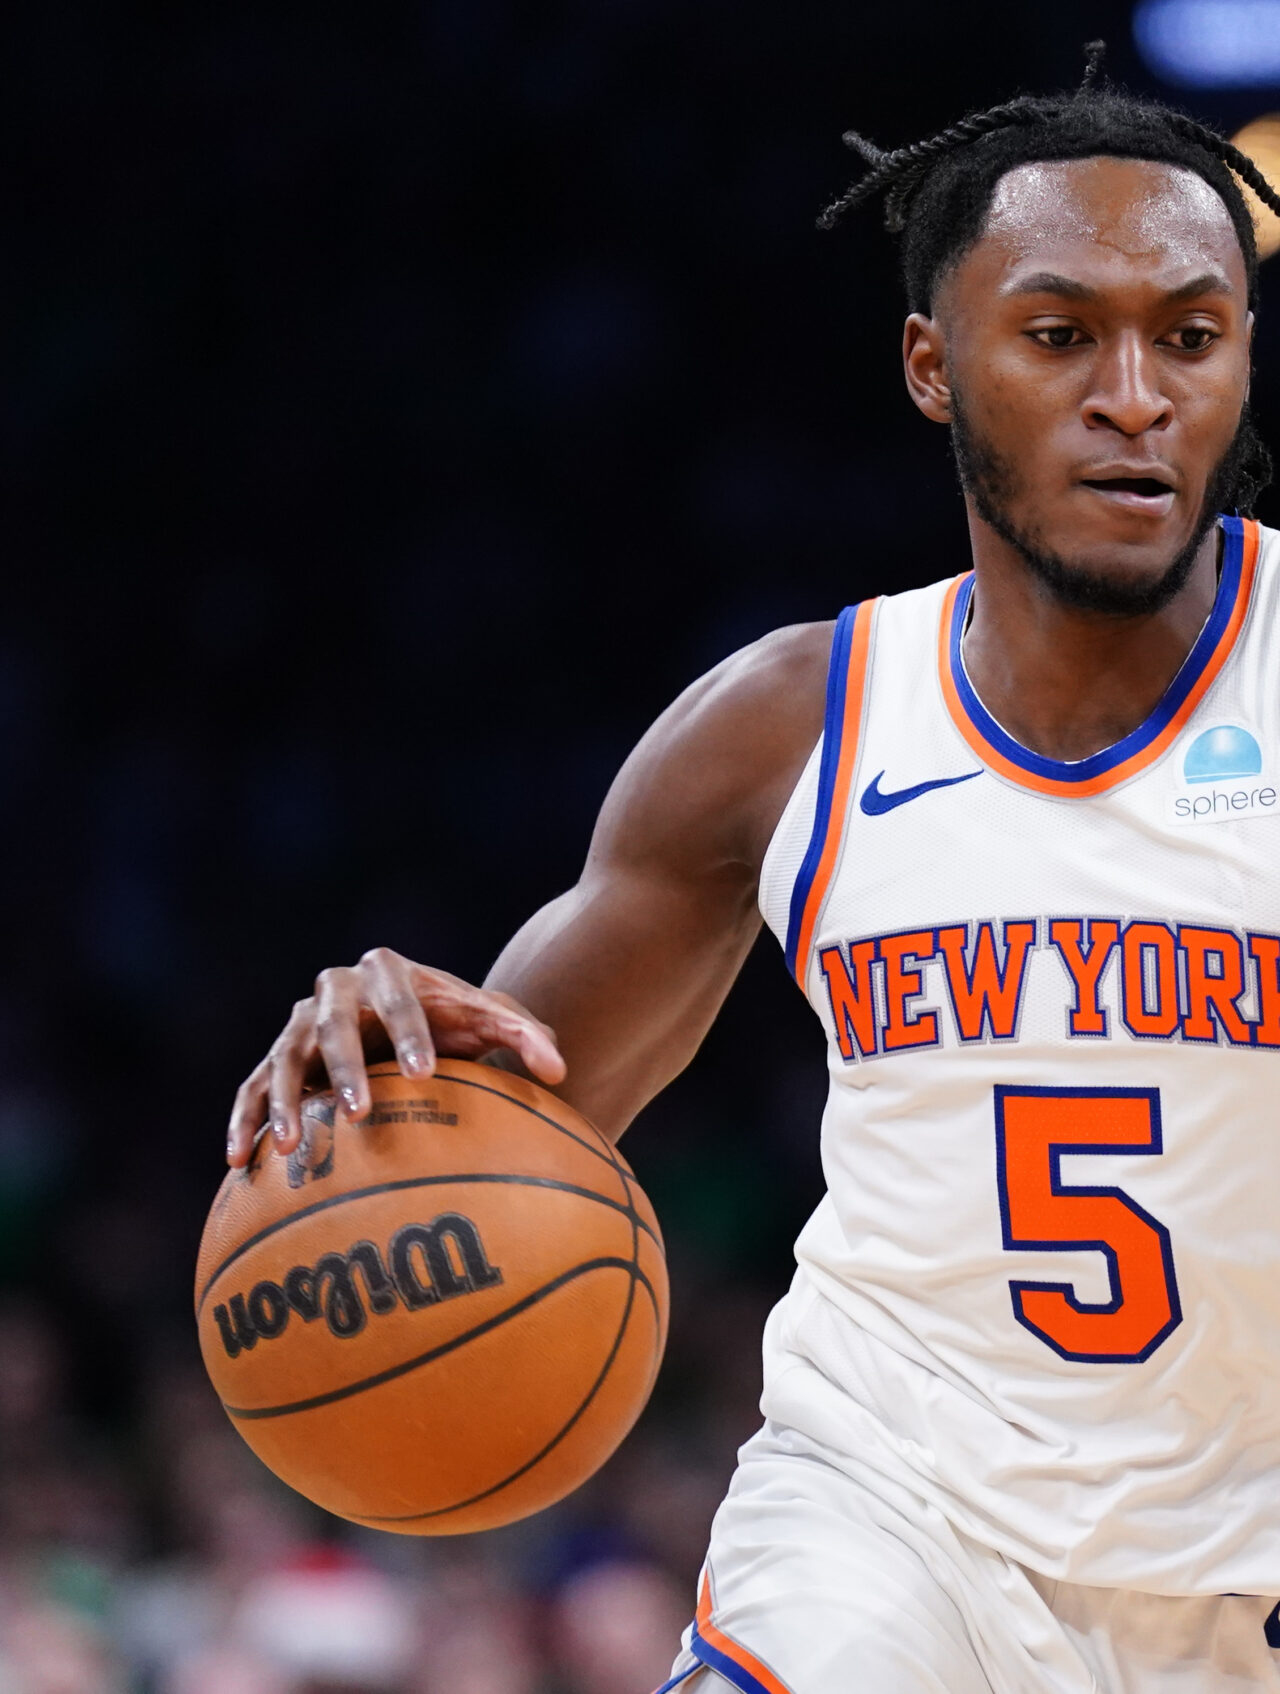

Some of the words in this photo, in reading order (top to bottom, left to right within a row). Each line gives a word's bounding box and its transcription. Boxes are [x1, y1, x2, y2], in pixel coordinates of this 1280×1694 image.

[1174, 784, 1278, 821] sphere
[818, 917, 1041, 1065] NEW
[213, 1212, 502, 1358] Wilson
[993, 1083, 1183, 1365] 5
